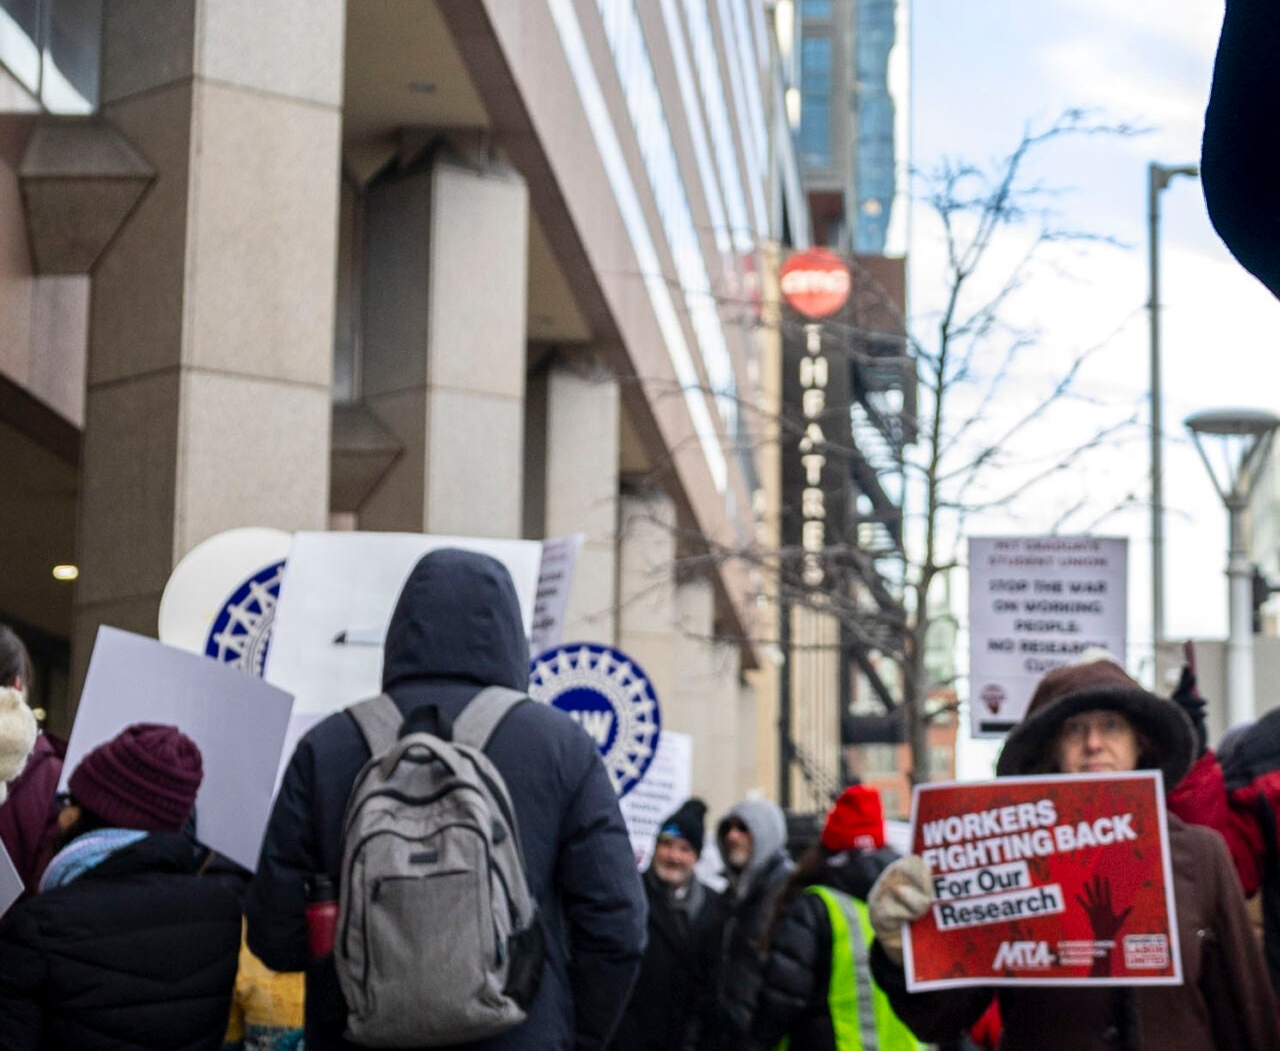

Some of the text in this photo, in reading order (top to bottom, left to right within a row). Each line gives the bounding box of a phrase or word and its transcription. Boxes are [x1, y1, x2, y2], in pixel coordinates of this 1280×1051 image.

[988, 579, 1108, 594] STOP THE WAR
[988, 639, 1014, 654] NO
[922, 799, 1058, 847] WORKERS
[922, 828, 1054, 872] FIGHTING
[1053, 813, 1138, 852] BACK
[932, 869, 1023, 900] For Our
[939, 888, 1057, 926] Research
